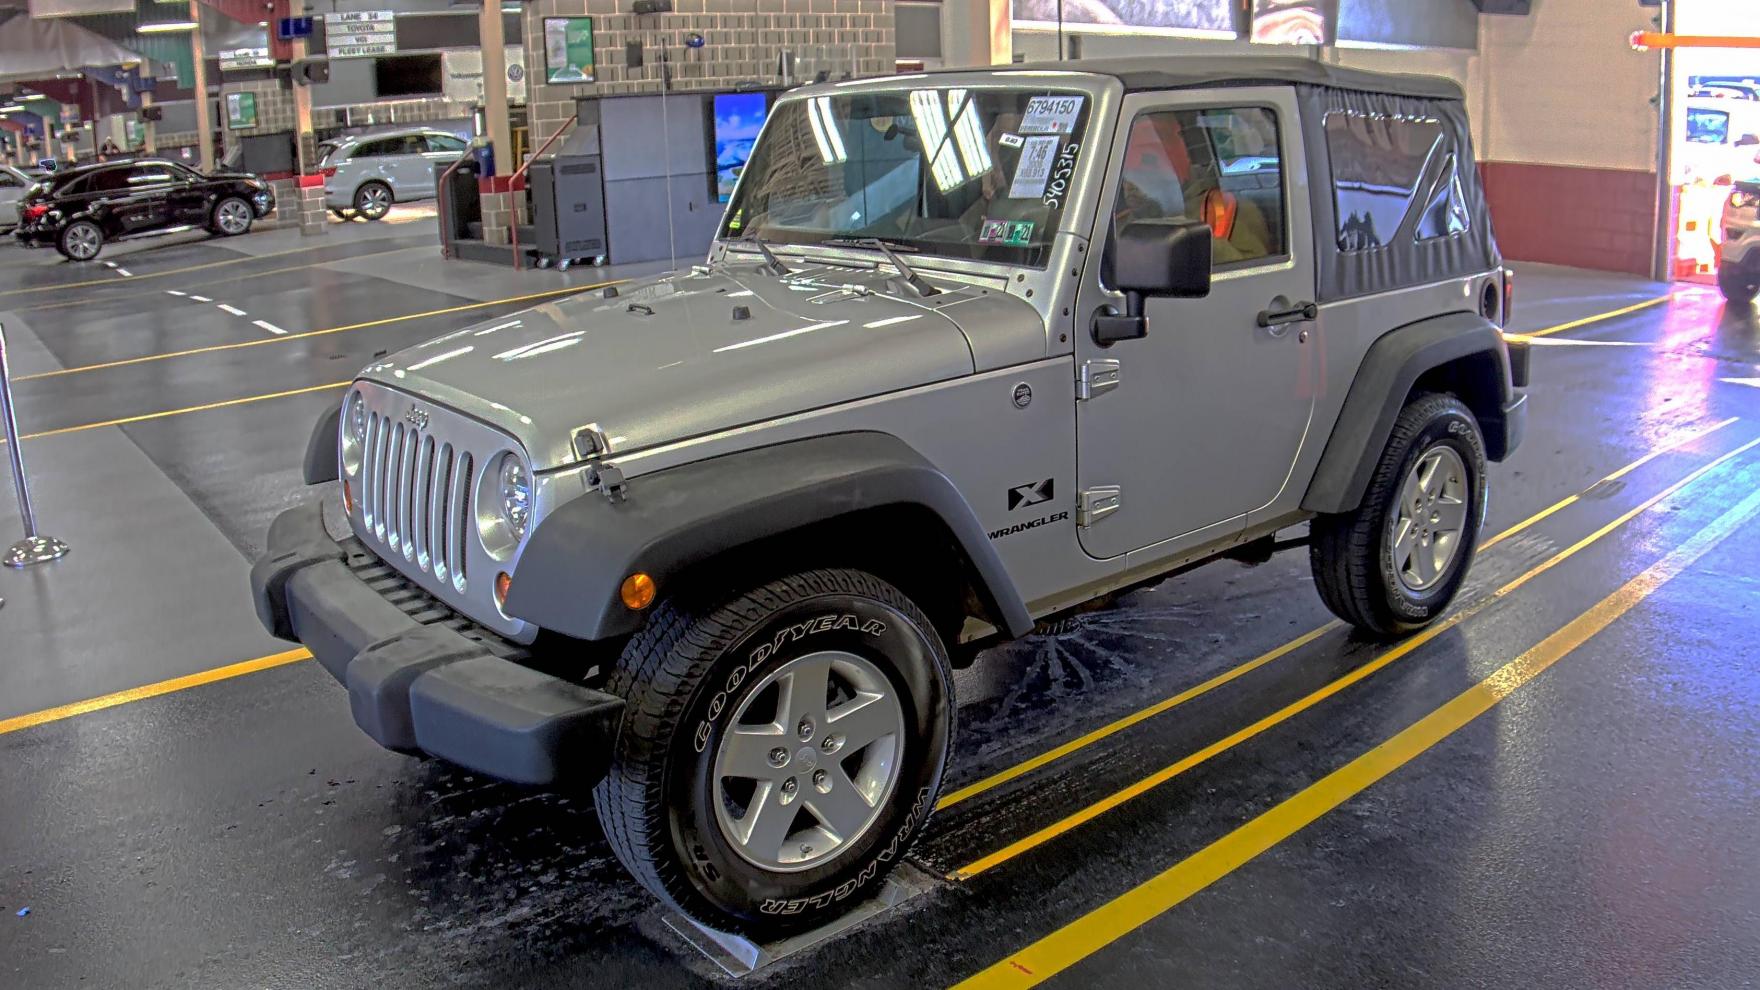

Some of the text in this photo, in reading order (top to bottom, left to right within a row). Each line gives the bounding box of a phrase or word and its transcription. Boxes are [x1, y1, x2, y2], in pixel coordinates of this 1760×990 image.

[340, 11, 361, 21] LANE
[347, 23, 375, 32] TOYOTA
[1027, 100, 1075, 114] 6794150
[987, 511, 1068, 540] WRANGLER
[694, 614, 887, 753] GOODYEAR
[760, 786, 932, 915] WRANGLER
